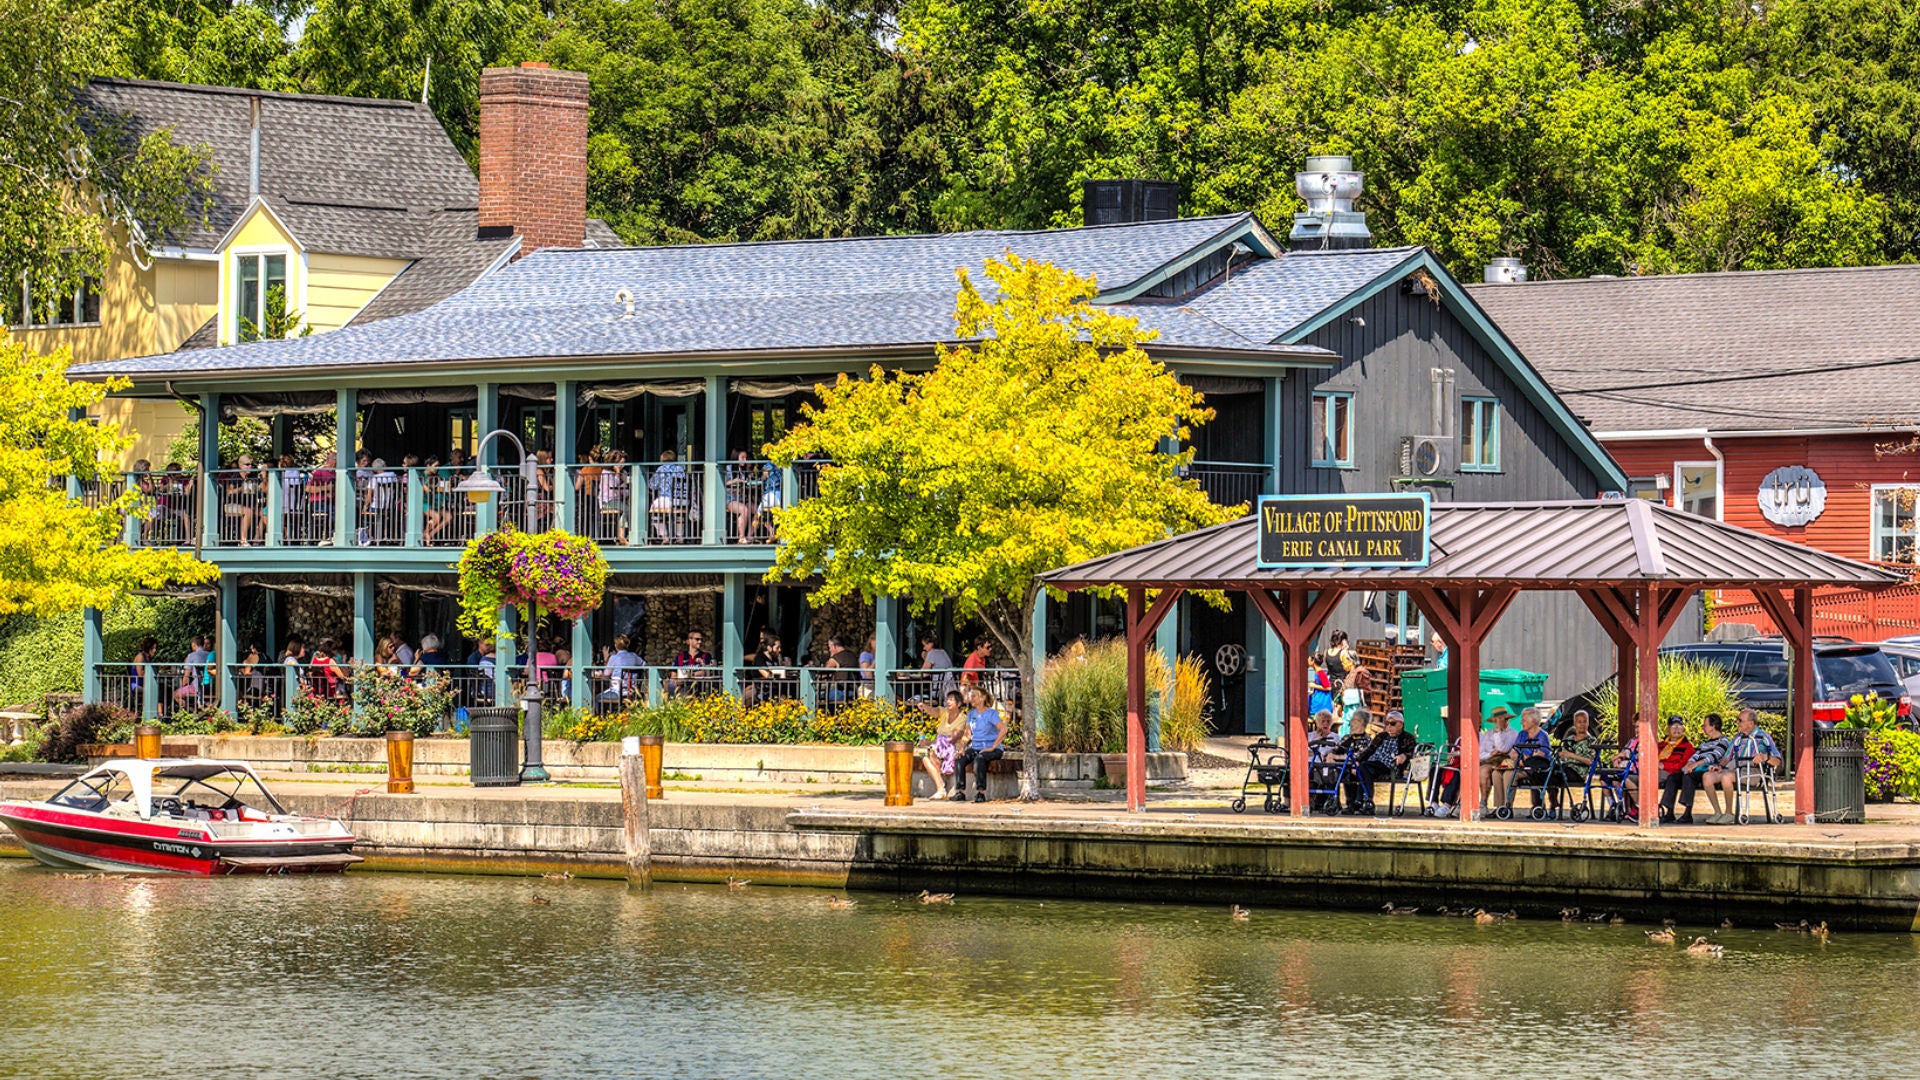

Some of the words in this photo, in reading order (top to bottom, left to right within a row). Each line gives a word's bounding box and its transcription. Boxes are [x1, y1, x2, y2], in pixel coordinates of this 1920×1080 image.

[1324, 511, 1343, 533] OF
[1282, 541, 1313, 557] ERIE
[1317, 540, 1362, 557] CANAL
[1367, 539, 1403, 557] PARK
